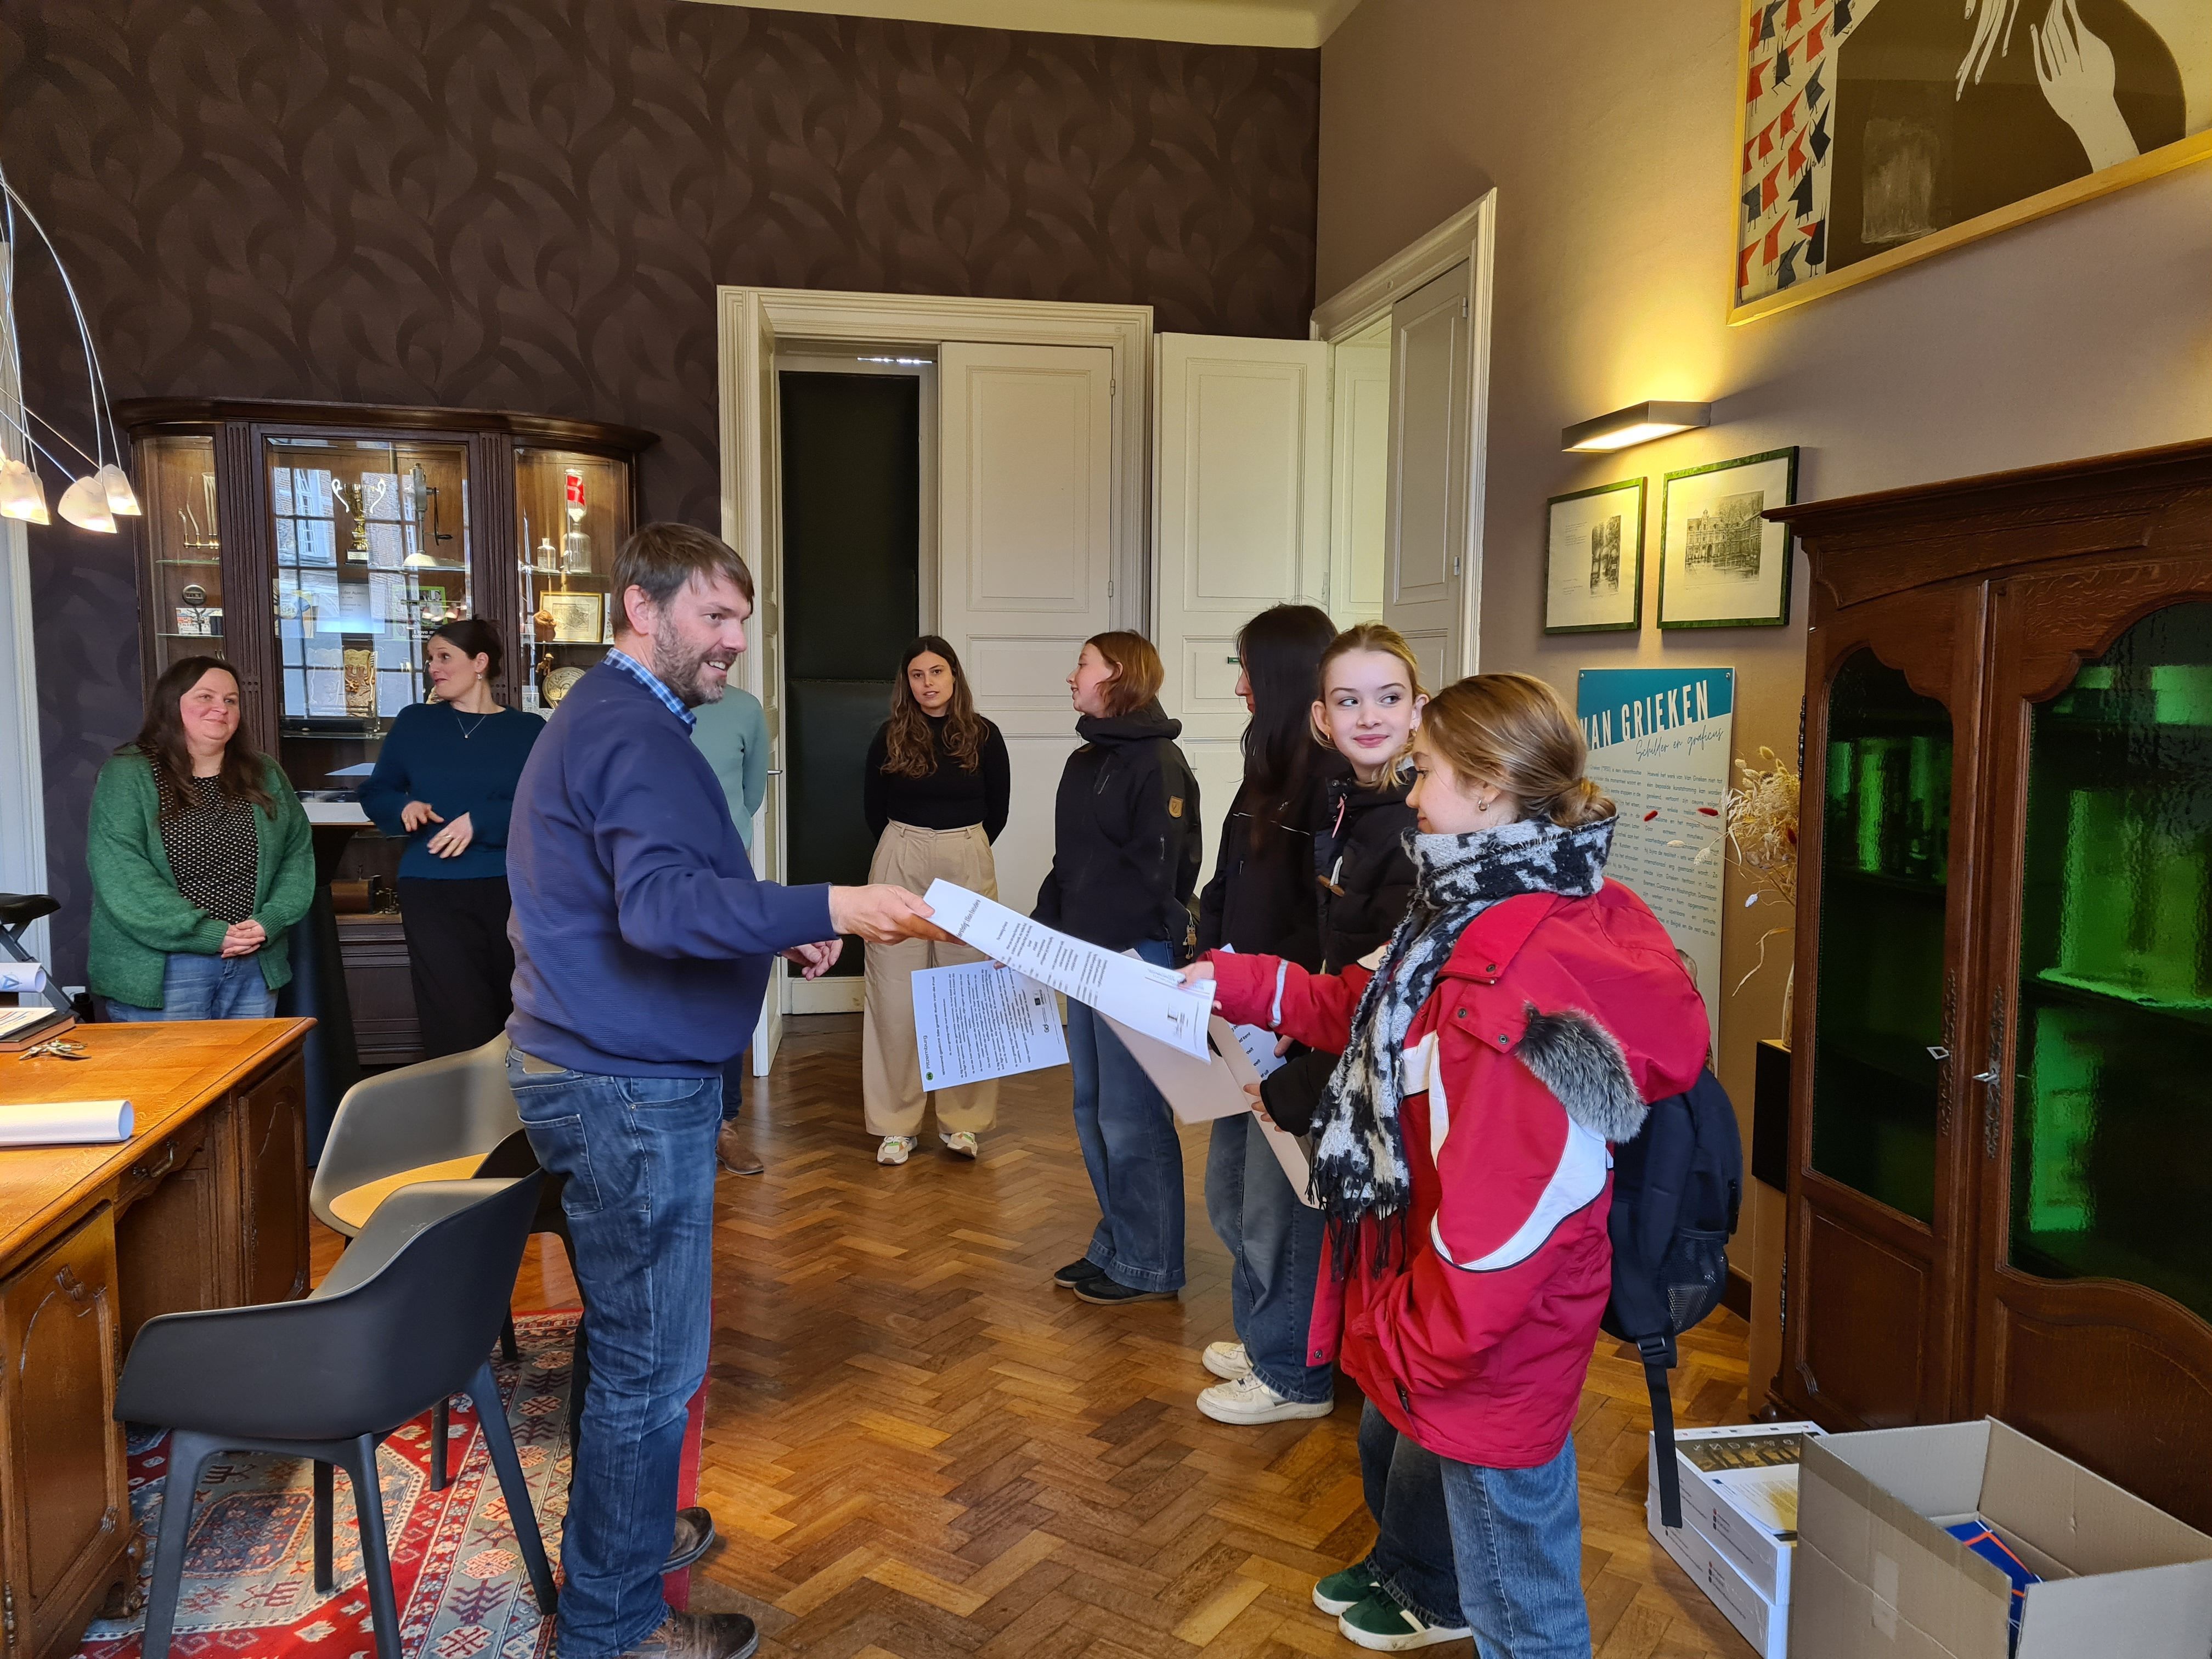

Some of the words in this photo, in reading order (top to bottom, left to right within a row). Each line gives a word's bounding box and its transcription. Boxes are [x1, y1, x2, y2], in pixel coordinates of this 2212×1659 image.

[1580, 710, 1612, 751] VAN
[1622, 680, 1708, 741] GRIEKEN
[1636, 736, 1669, 761] Schilder
[1673, 740, 1682, 749] en
[1688, 725, 1723, 755] graficus
[922, 1035, 931, 1069] Pitzemburg
